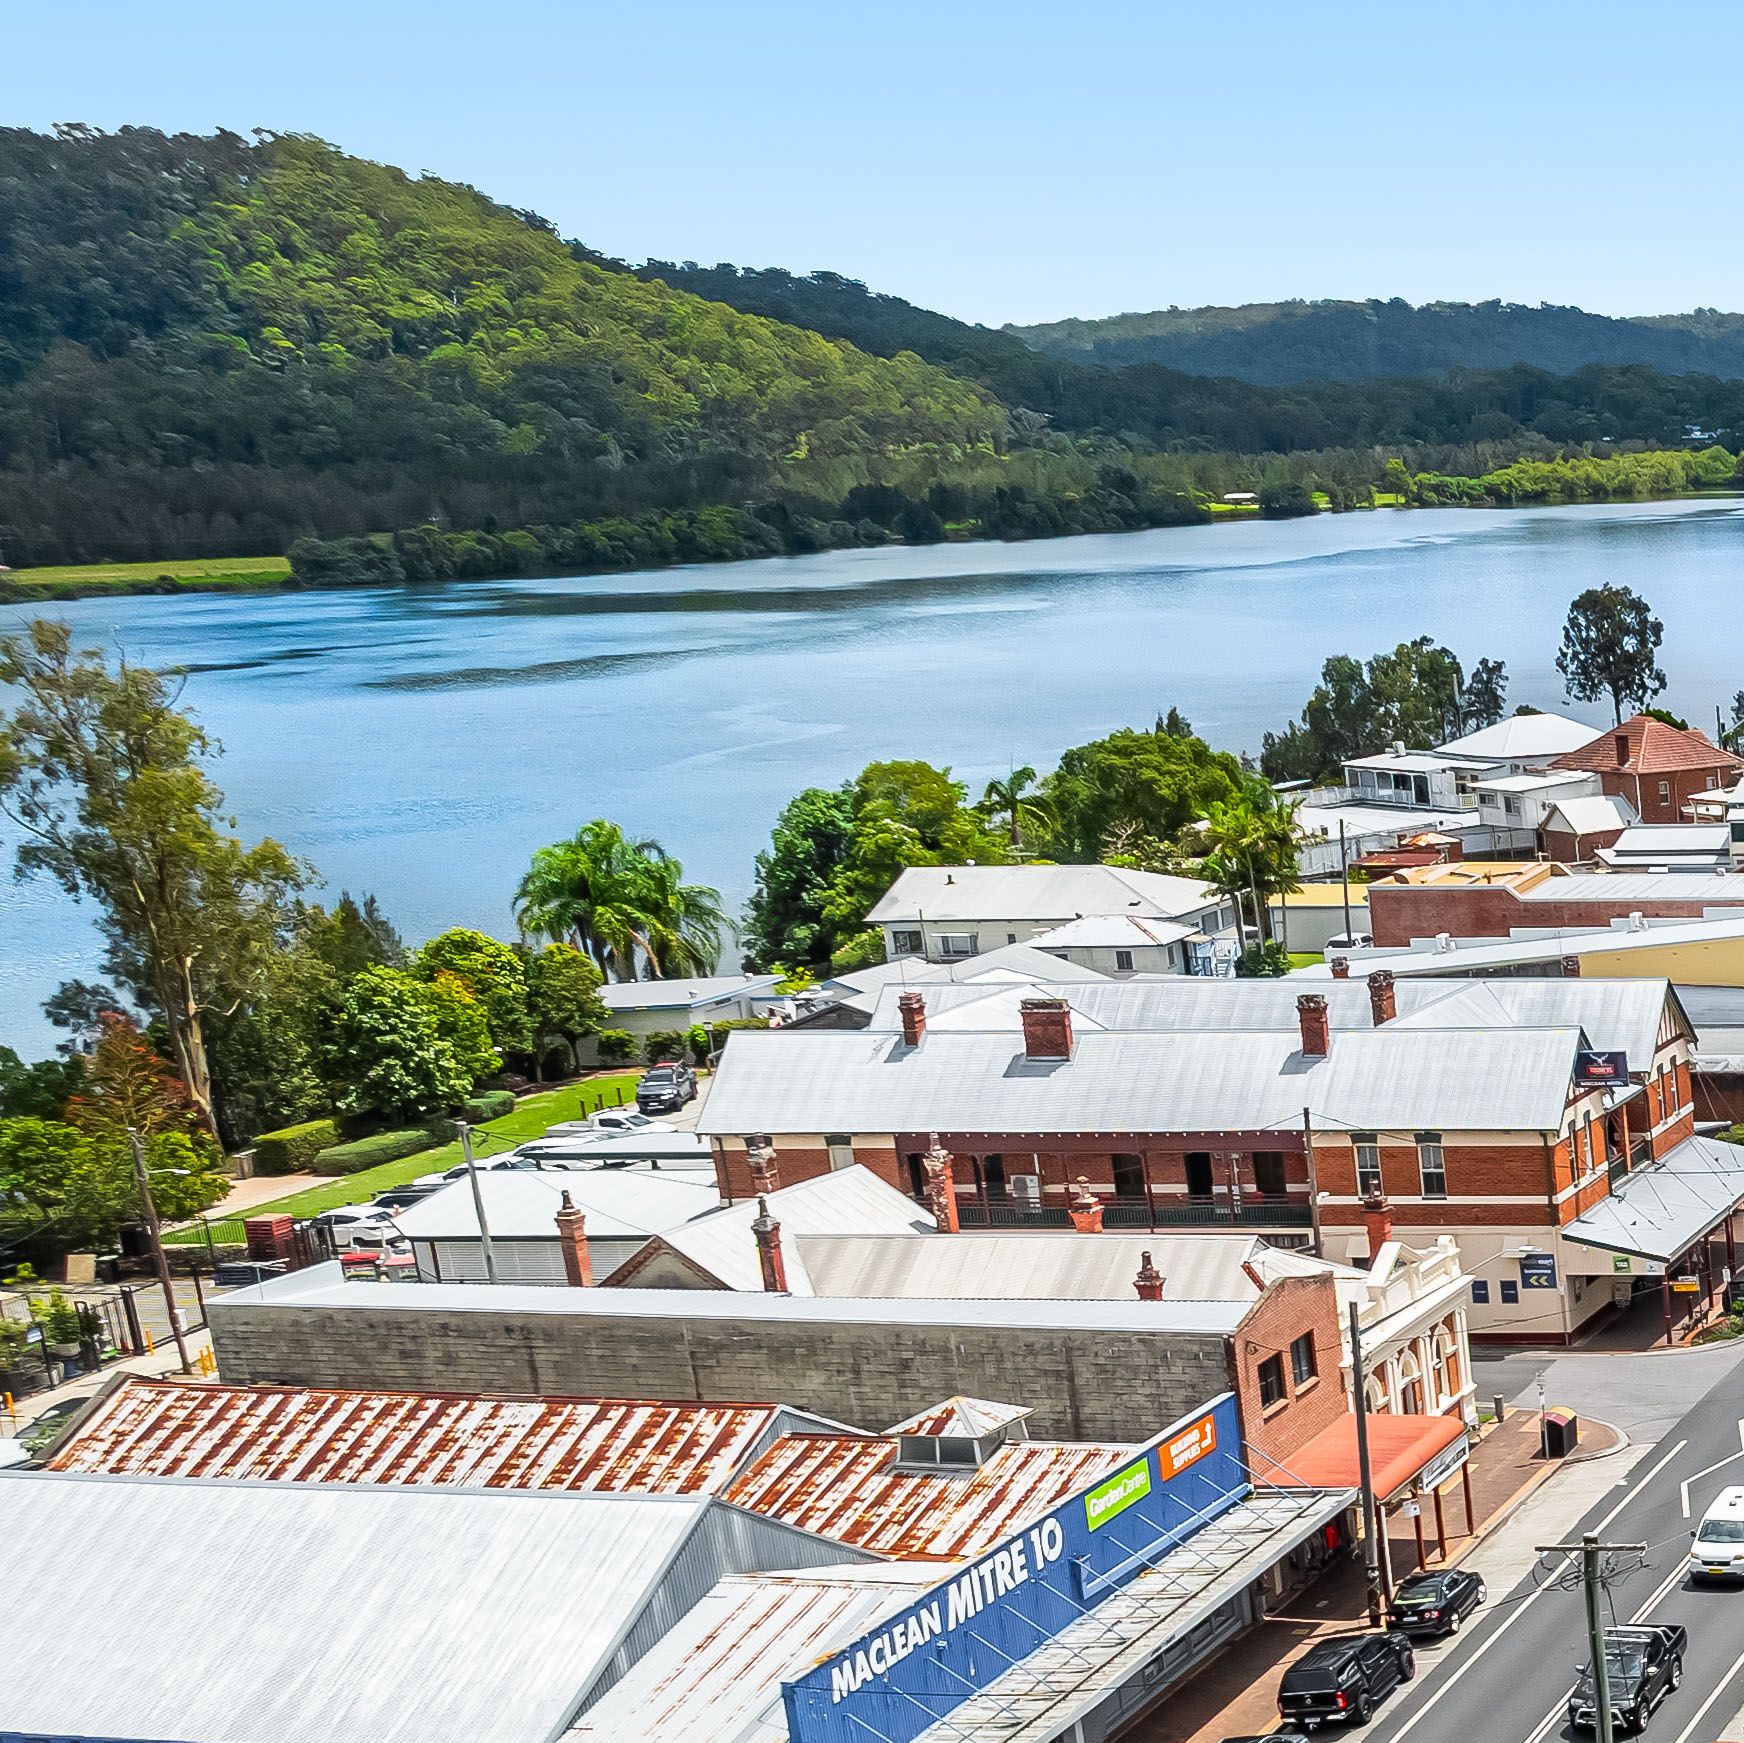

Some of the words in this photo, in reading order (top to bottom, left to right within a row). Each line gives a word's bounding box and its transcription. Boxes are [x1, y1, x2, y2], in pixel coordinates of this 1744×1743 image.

[831, 1600, 942, 1704] MACLEAN
[947, 1541, 1030, 1632] MITRE
[1029, 1518, 1063, 1571] 10
